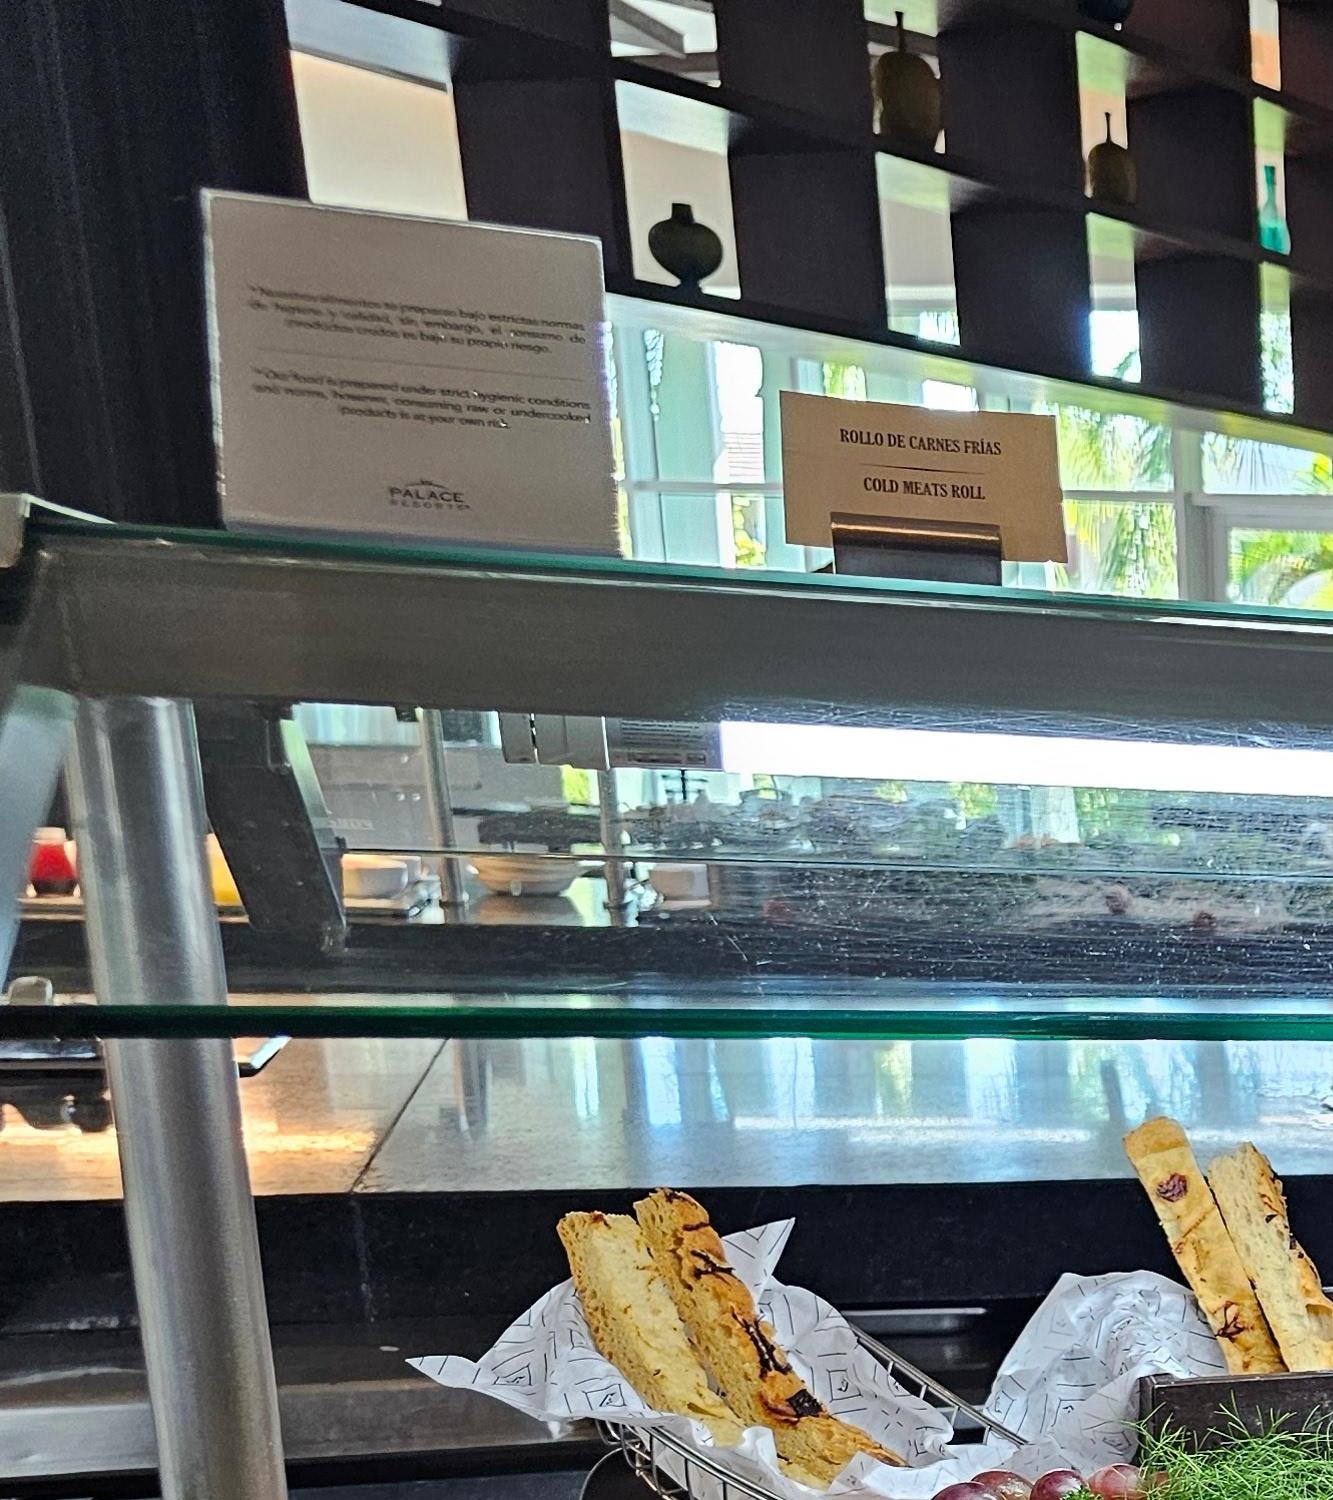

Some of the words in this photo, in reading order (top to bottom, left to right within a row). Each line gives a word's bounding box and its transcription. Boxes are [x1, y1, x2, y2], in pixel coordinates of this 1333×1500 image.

[458, 308, 486, 322] bajo
[541, 319, 585, 331] normas
[511, 341, 552, 355] riesgo.
[569, 333, 586, 345] de
[340, 378, 398, 392] prepared
[401, 384, 436, 396] under
[440, 387, 470, 399] strict
[473, 389, 525, 405] hygienic
[528, 396, 591, 410] conditions
[340, 404, 397, 420] products
[429, 414, 455, 426] your
[460, 417, 485, 427] own
[466, 404, 489, 414] raw
[493, 407, 506, 415] or
[511, 408, 591, 423] undercooked
[840, 428, 883, 447] ROLLO
[888, 433, 906, 448] DE
[909, 435, 960, 453] CARNES
[964, 439, 1001, 455] FRÍAS
[389, 487, 465, 502] PALACE
[863, 477, 898, 493] COLD
[903, 481, 947, 498] MEATS
[951, 485, 985, 500] ROLL
